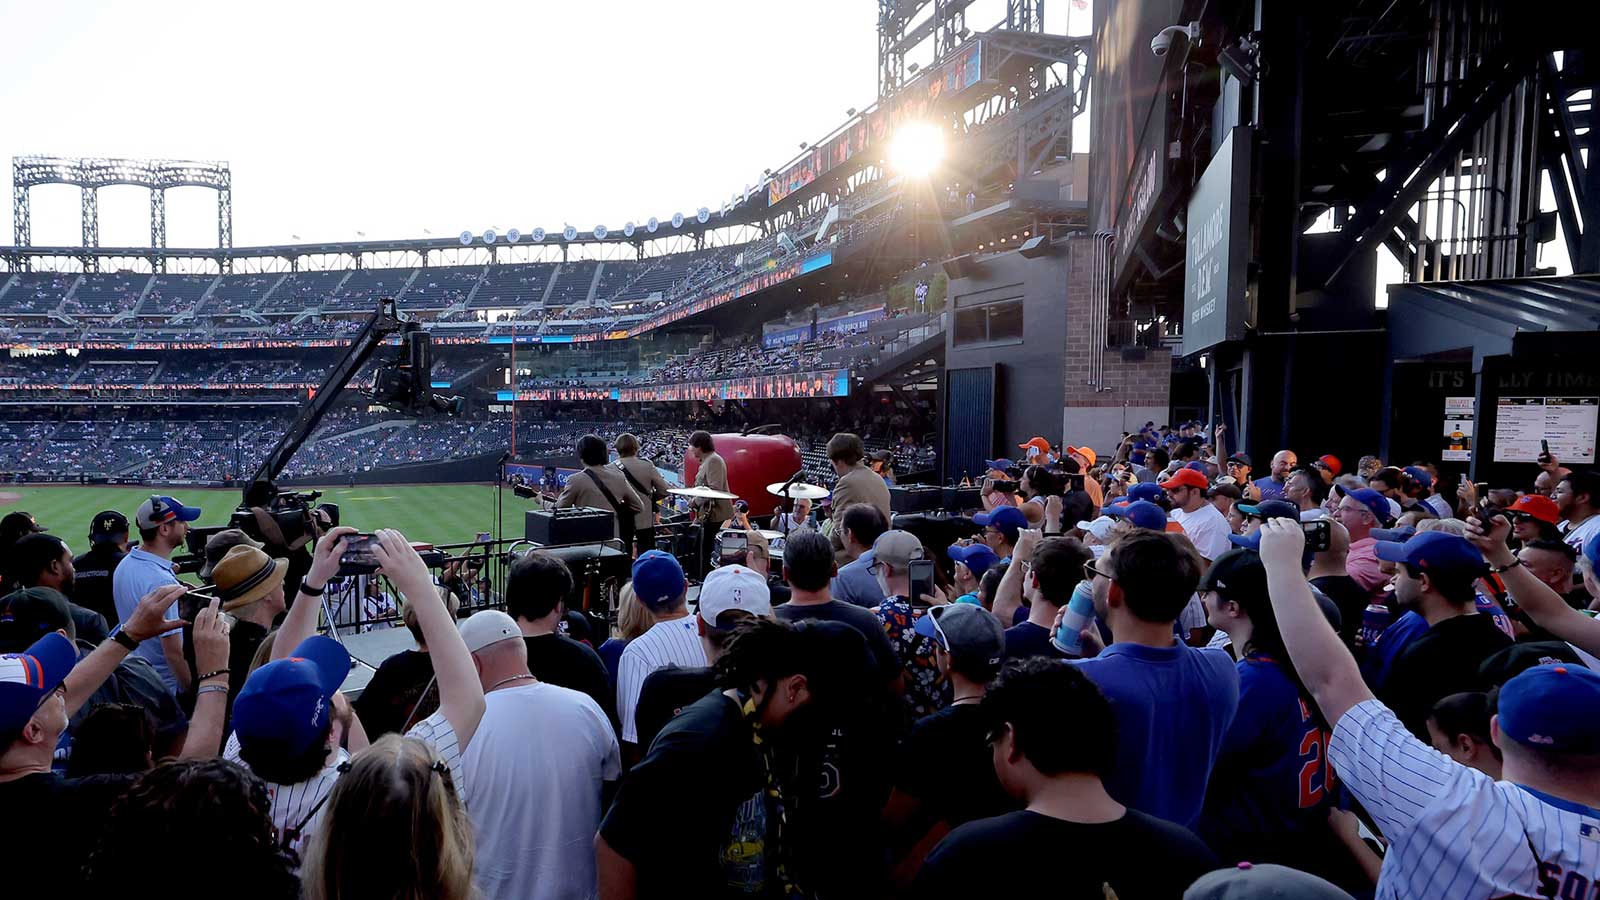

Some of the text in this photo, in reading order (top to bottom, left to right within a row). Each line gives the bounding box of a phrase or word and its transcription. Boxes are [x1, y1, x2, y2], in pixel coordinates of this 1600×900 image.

[534, 230, 543, 239] 24
[566, 229, 574, 237] 17
[1429, 370, 1465, 389] IT'S
